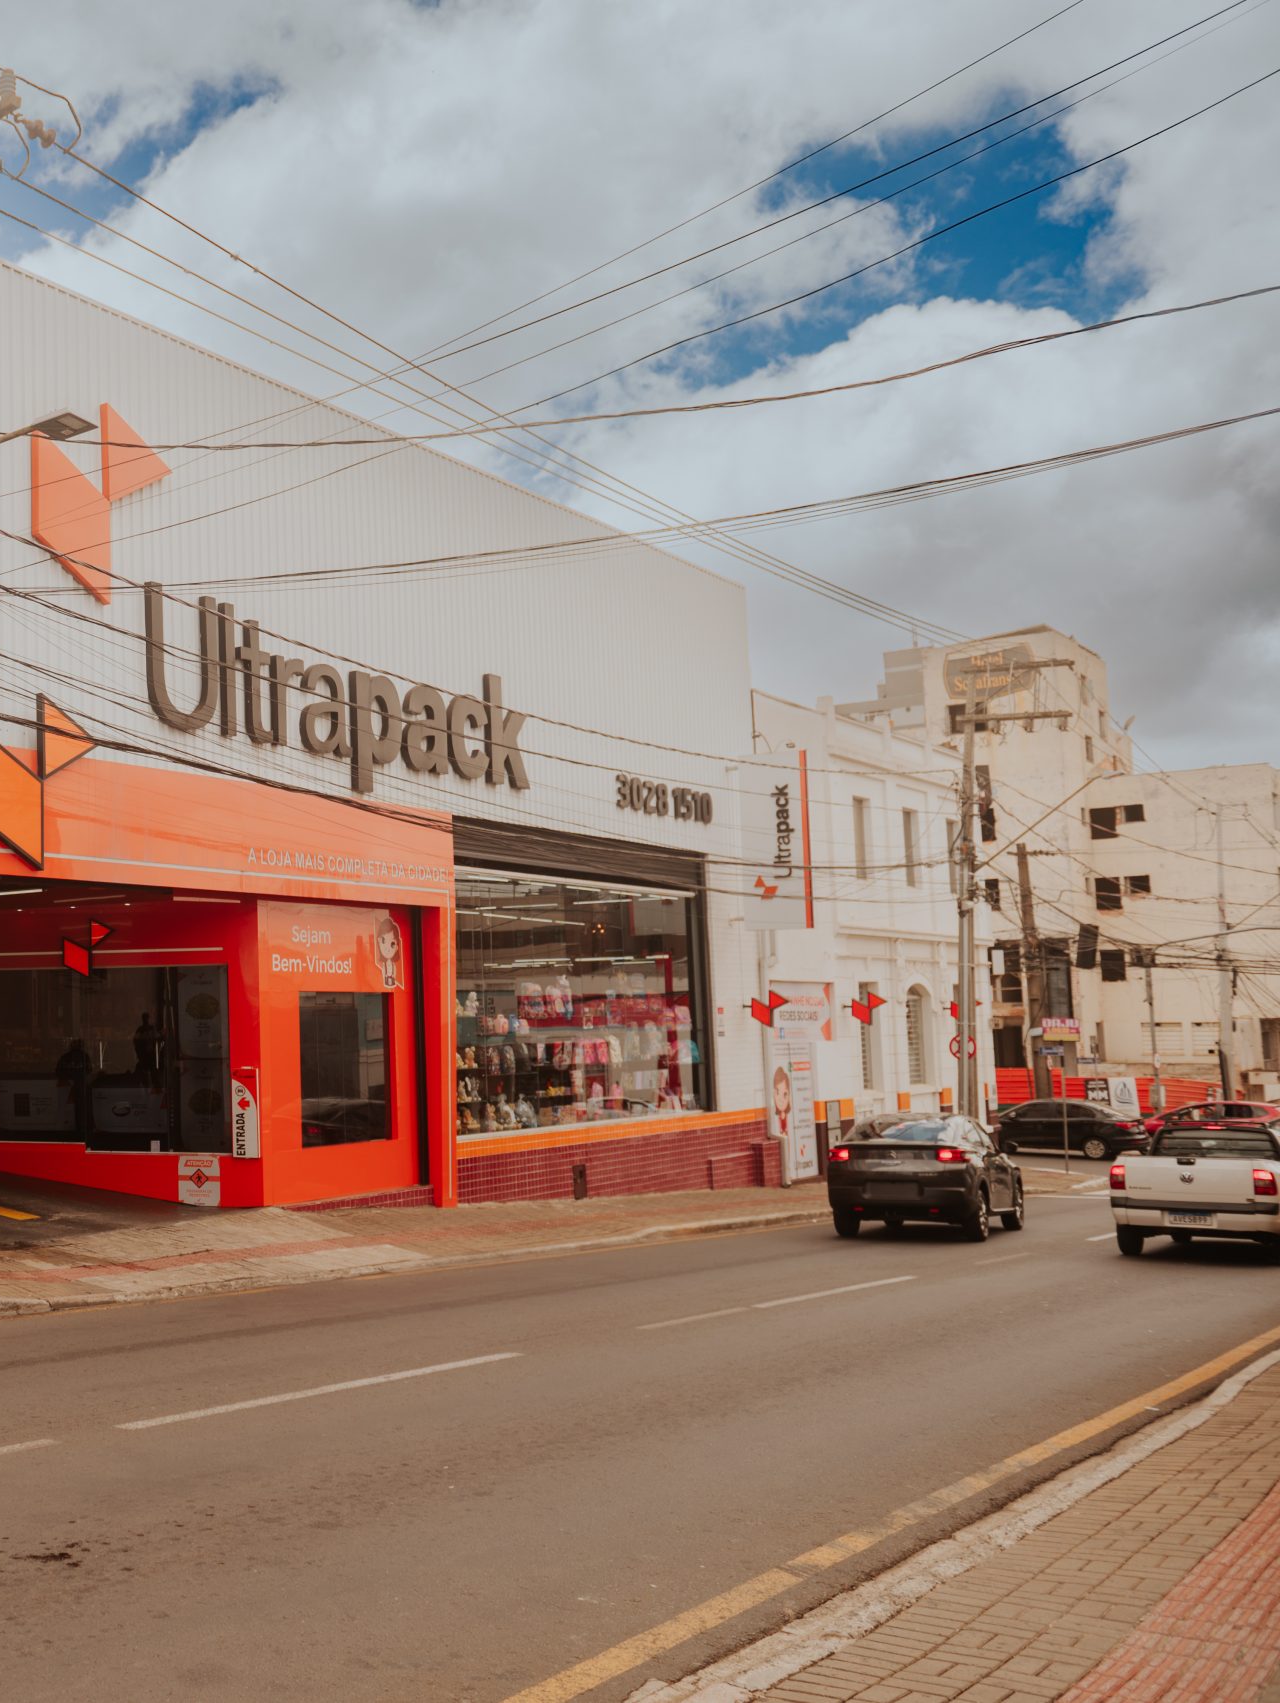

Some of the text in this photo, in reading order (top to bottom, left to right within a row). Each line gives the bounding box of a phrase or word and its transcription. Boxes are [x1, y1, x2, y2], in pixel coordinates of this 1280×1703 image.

[144, 581, 531, 793] Ultrapack
[615, 773, 713, 825] 3028 1510
[770, 784, 795, 879] Ultrapack
[248, 848, 257, 864] A
[260, 849, 291, 867] LOJA
[295, 852, 325, 871] MAIS
[328, 856, 388, 877] COMPLETA
[391, 863, 406, 878] DA
[291, 924, 332, 948] Sejam
[272, 953, 353, 974] Bem-Vindos!
[236, 1112, 246, 1157] ENTRADA
